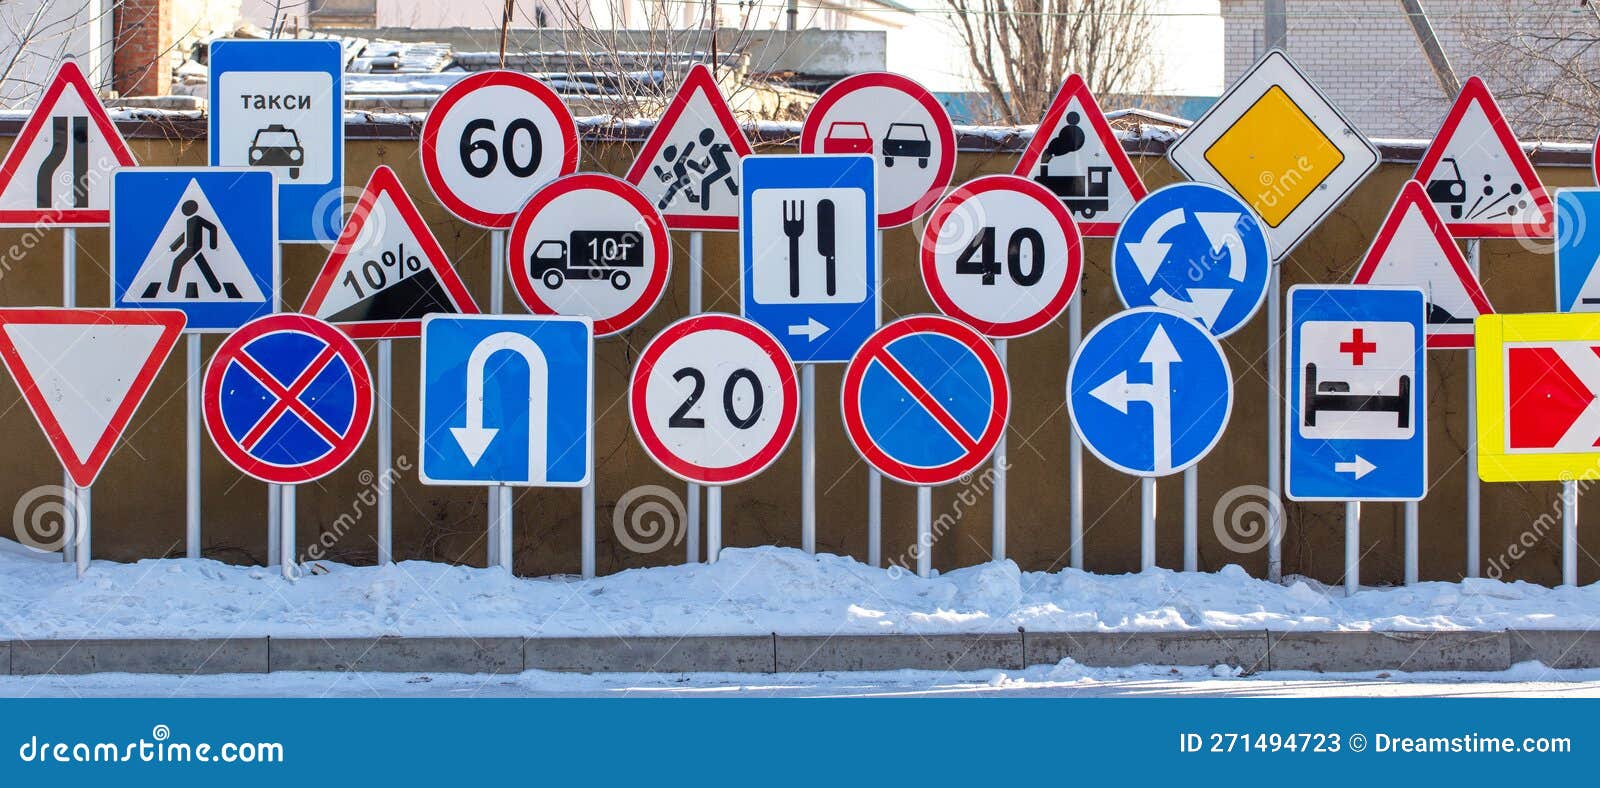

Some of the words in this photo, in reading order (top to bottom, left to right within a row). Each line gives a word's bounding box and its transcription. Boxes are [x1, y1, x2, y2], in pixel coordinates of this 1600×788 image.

[241, 95, 311, 110] такси
[459, 118, 543, 179] 60
[343, 243, 421, 299] 10%
[956, 227, 1046, 287] 40
[668, 367, 764, 430] 20
